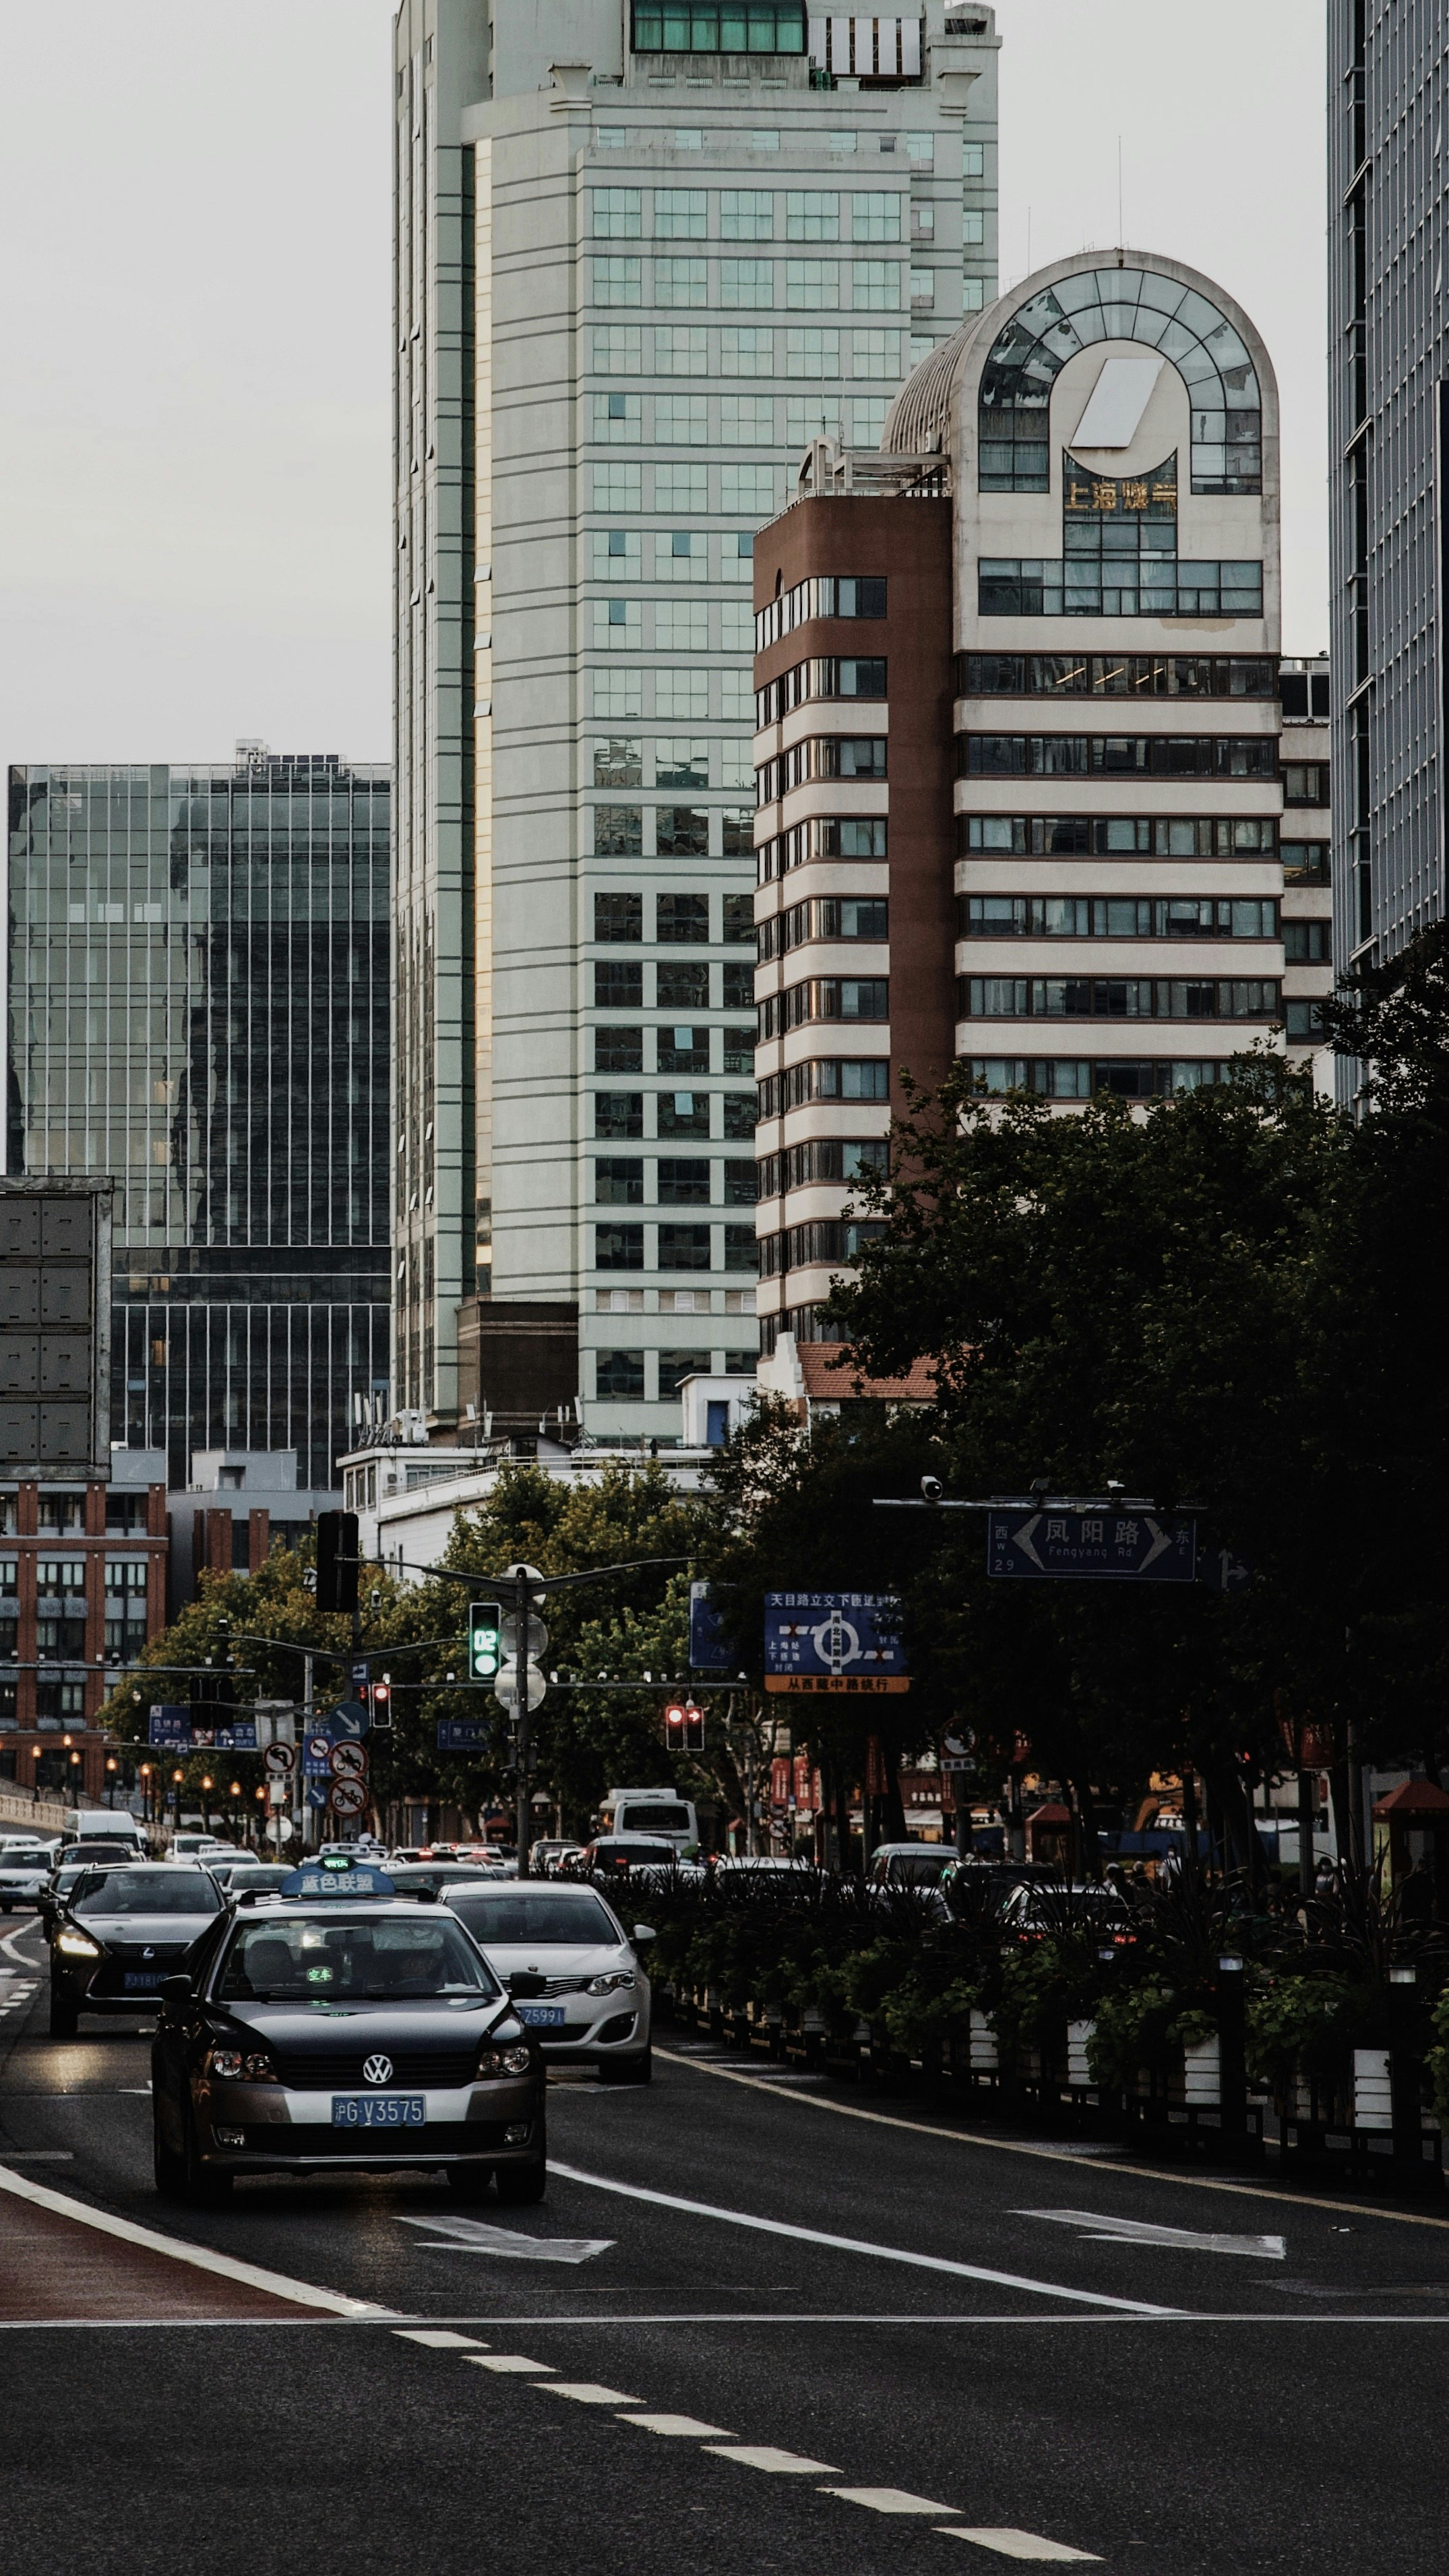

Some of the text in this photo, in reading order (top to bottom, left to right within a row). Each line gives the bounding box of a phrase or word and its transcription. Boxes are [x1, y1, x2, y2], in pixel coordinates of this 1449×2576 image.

[1065, 482, 1177, 510] 上海燃气
[994, 1525, 1008, 1540] 西
[1045, 1519, 1140, 1545] 凤阳路
[1175, 1530, 1190, 1545] 东
[997, 1542, 1006, 1551] W
[1049, 1546, 1135, 1559] Fengyang Rd.
[1179, 1547, 1186, 1556] E
[995, 1559, 1014, 1571] 29
[788, 1678, 888, 1690] 从西藏中路绕行
[301, 1873, 374, 1892] 蓝色联盟
